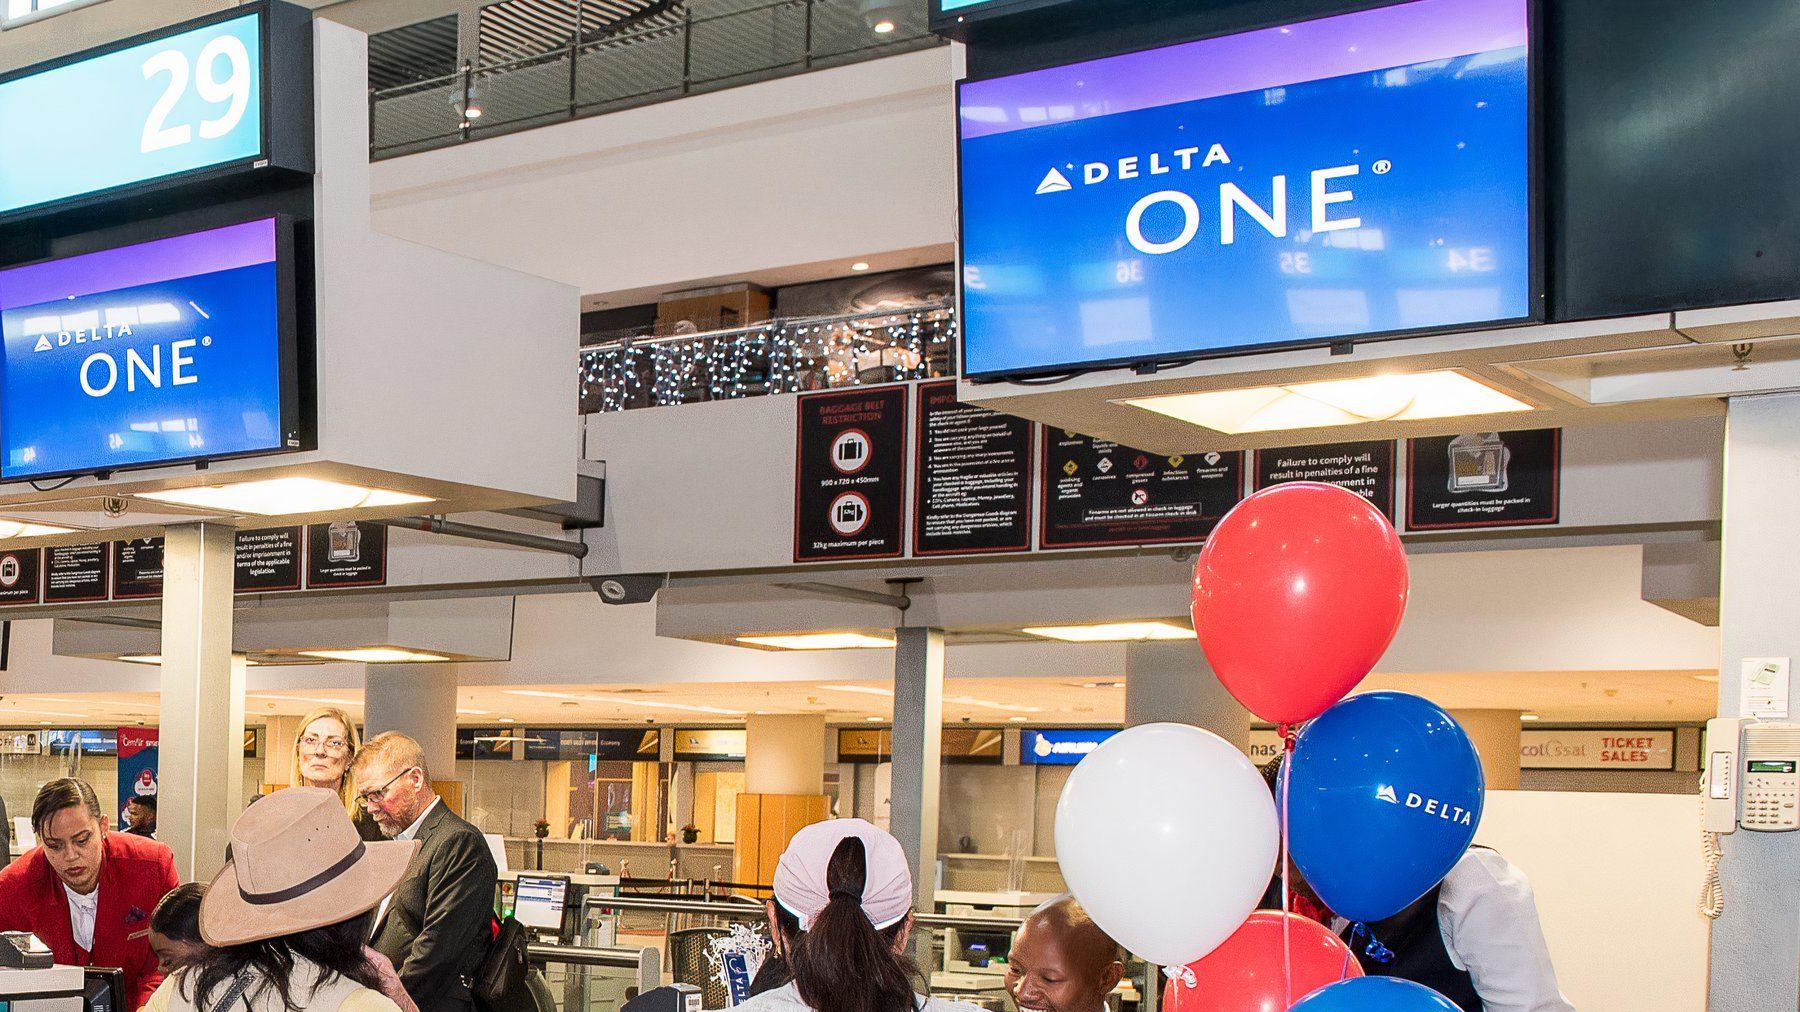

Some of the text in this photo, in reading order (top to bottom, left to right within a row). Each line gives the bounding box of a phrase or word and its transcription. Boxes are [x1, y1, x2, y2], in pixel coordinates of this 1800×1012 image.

[140, 35, 251, 154] 29
[1083, 143, 1232, 186] DELTA
[1125, 164, 1361, 255] ONE
[56, 321, 133, 349] DELTA
[79, 350, 199, 398] ONE
[1269, 470, 1294, 479] result
[1295, 470, 1303, 478] in
[1304, 467, 1343, 479] penalties
[1344, 465, 1354, 474] of
[1361, 465, 1378, 473] fine
[1277, 458, 1306, 467] Failure
[1320, 454, 1353, 465] comply
[1354, 453, 1371, 462] will
[1366, 477, 1375, 485] in
[1601, 750, 1649, 762] SALES
[1602, 738, 1654, 749] TICKET
[1405, 792, 1471, 826] DELTA
[736, 977, 746, 1004] ELTA
